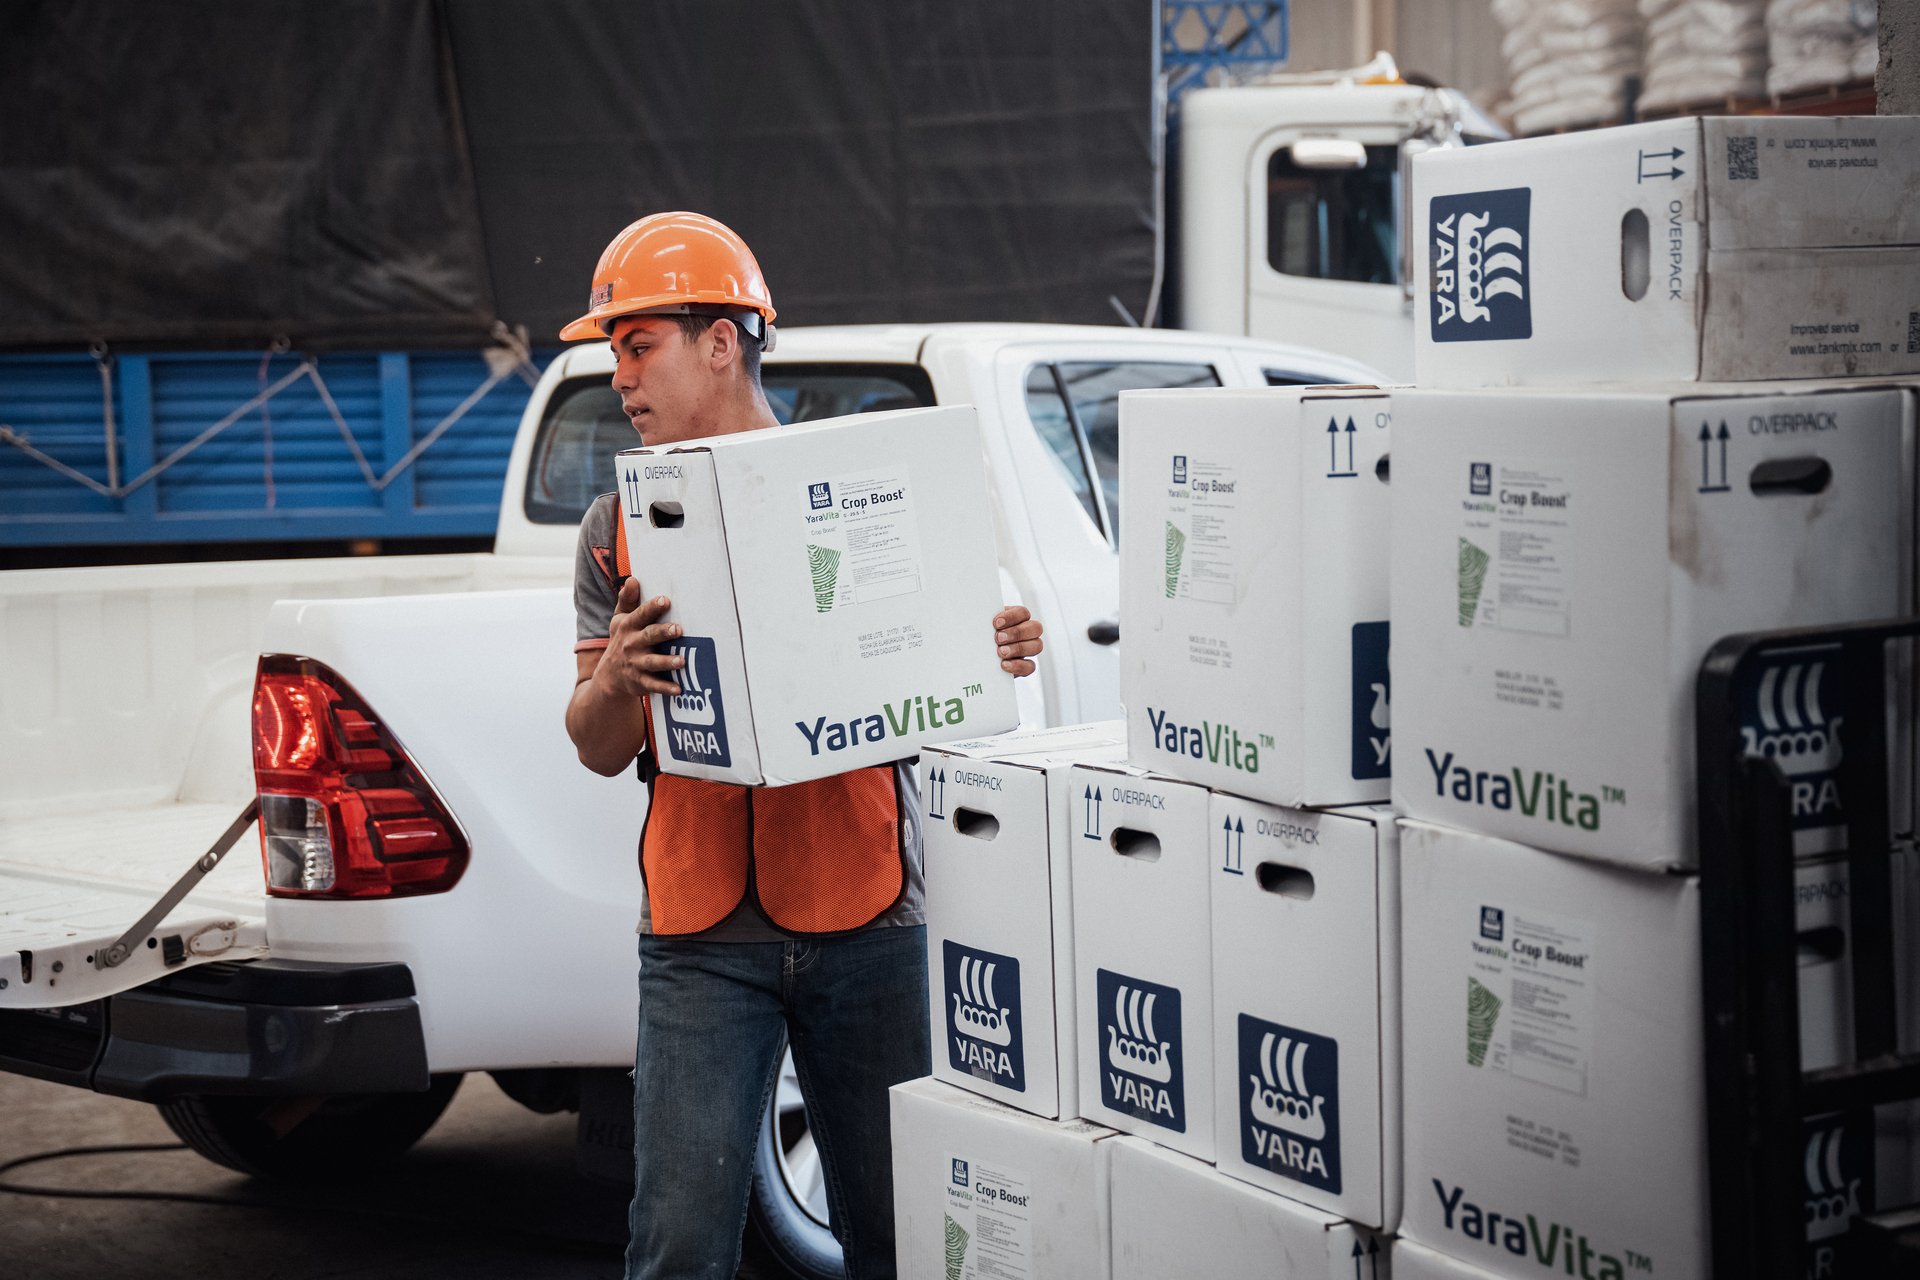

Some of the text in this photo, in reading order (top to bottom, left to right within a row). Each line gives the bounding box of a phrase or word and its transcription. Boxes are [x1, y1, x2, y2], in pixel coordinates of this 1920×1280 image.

[1669, 200, 1683, 300] OVERPACK
[1436, 212, 1457, 325] YARA
[1749, 413, 1838, 436] OVERPACK
[644, 465, 683, 481] OVERPACK
[841, 498, 868, 510] Crop
[672, 727, 722, 756] YARA
[955, 770, 1002, 791] OVERPACK
[1112, 787, 1165, 810] OVERPACK
[1792, 780, 1842, 816] RA
[1256, 819, 1319, 846] OVERPACK
[955, 1036, 1015, 1079] YARA
[1109, 1072, 1175, 1119] YARA
[1250, 1124, 1329, 1179] YARA
[976, 1182, 997, 1199] Crop
